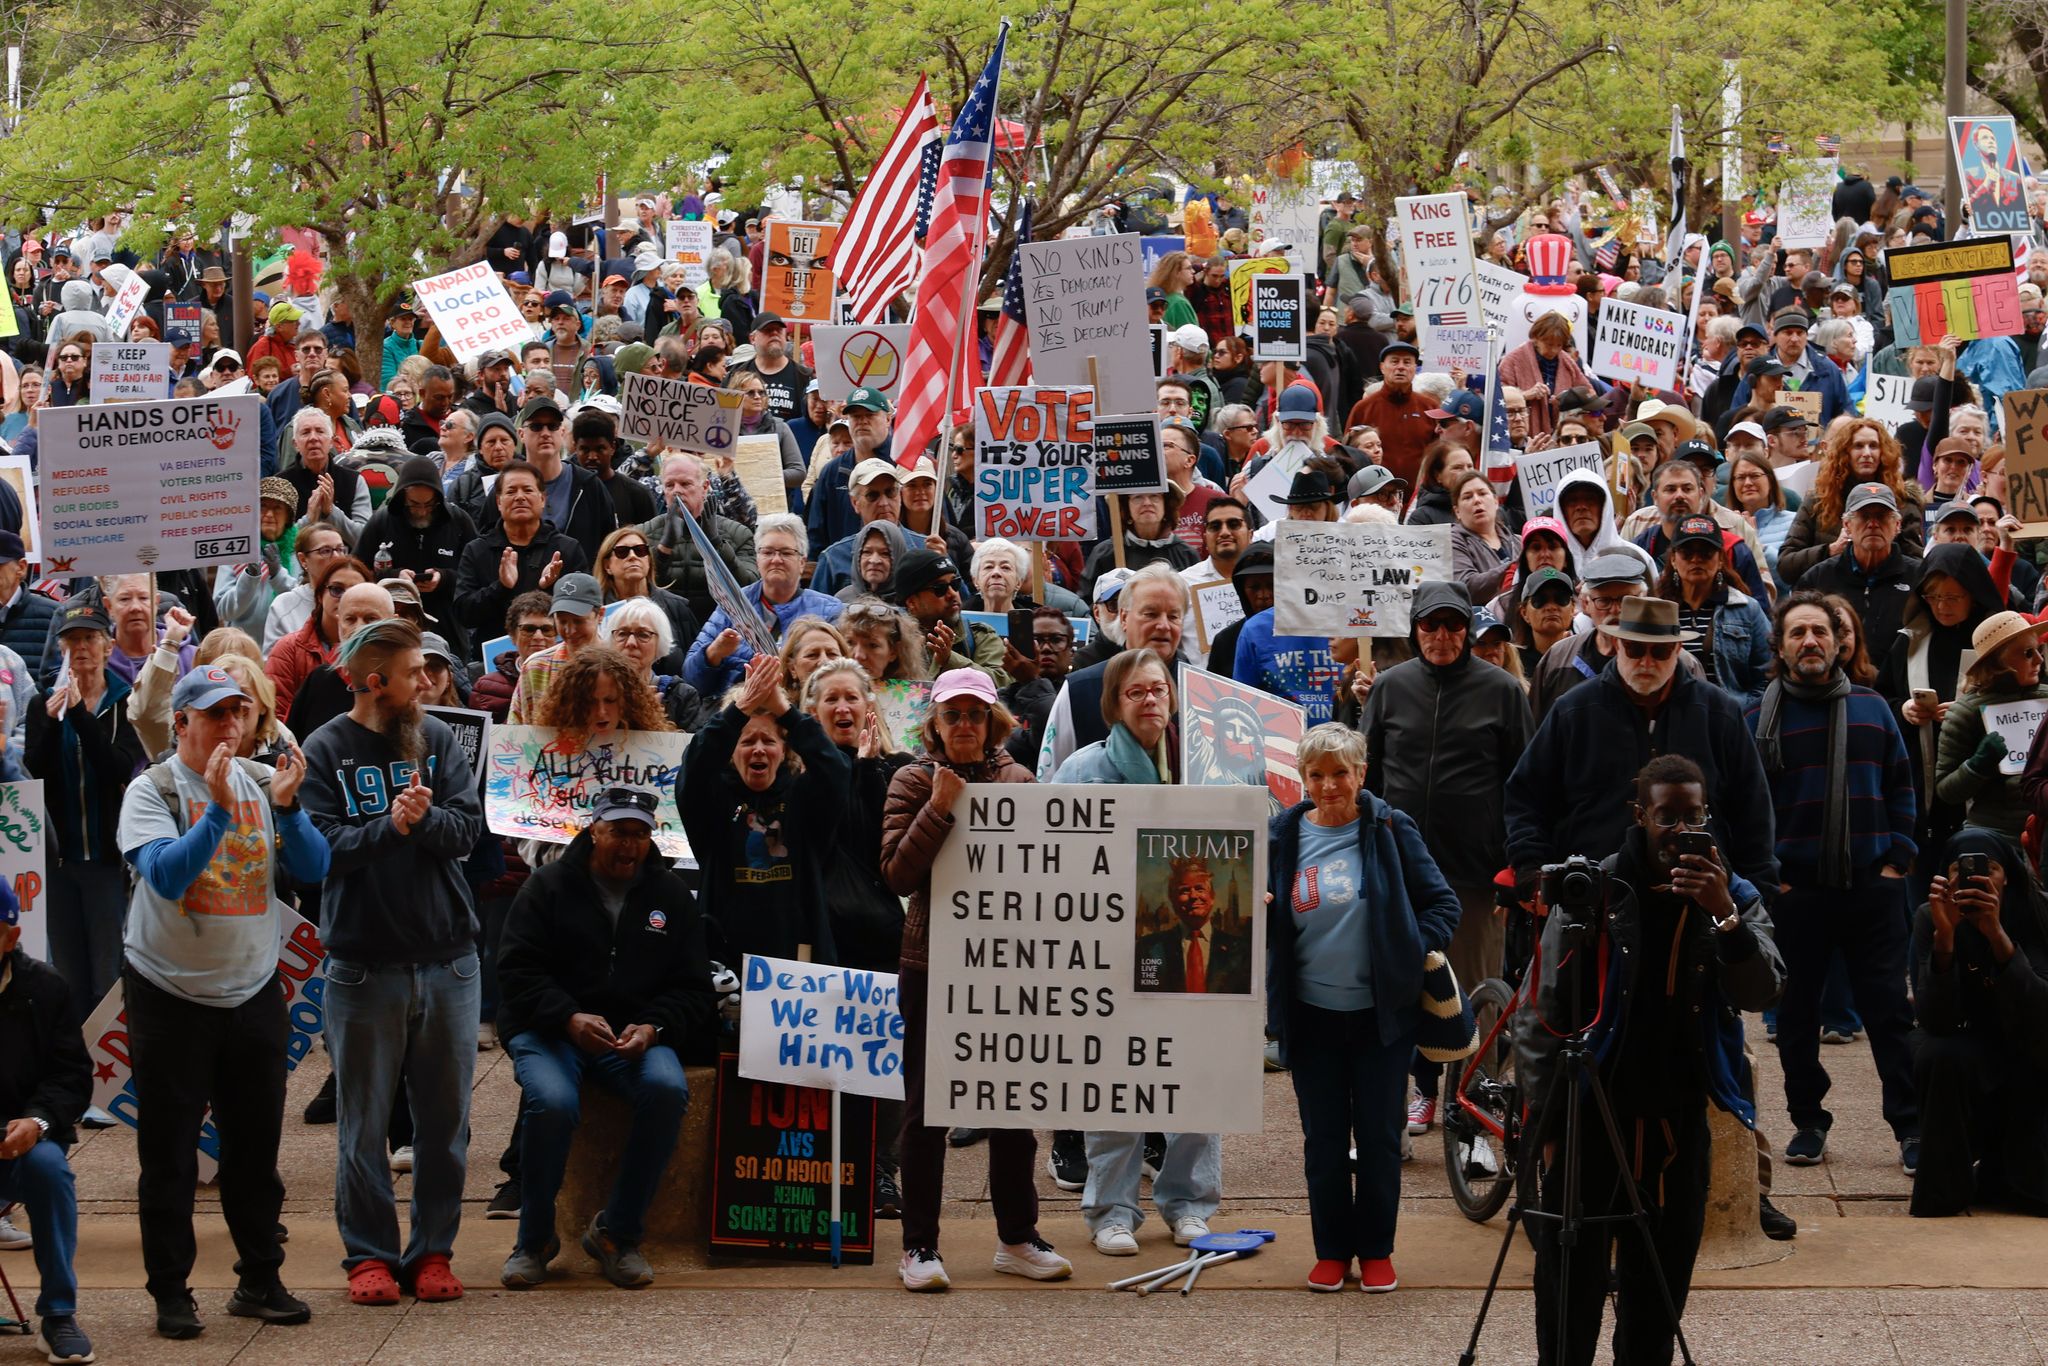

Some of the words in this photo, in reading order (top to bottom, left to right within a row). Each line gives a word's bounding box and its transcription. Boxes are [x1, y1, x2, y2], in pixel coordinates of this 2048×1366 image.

[1253, 210, 1284, 225] ARE
[1409, 202, 1452, 221] KING
[1975, 210, 2029, 229] LOVE
[793, 237, 813, 253] DEI
[1252, 228, 1316, 244] GOVERNING
[1413, 231, 1457, 249] FREE
[1029, 249, 1062, 275] NO
[1075, 241, 1134, 270] KINGS
[415, 264, 488, 296] UNPAID
[1032, 281, 1054, 299] YES
[1061, 274, 1122, 297] DEMOCRACY
[1414, 272, 1472, 308] 1776
[1503, 282, 1516, 291] OF
[433, 286, 500, 312] LOCAL
[1258, 287, 1279, 299] NO
[167, 308, 174, 320] A
[1040, 304, 1062, 324] NO
[1071, 295, 1125, 320] TRUMP
[1258, 299, 1298, 311] KINGS
[1259, 311, 1270, 320] IN
[1271, 311, 1292, 320] OUR
[1892, 280, 2013, 341] VOTE
[456, 306, 501, 330] PRO
[1259, 320, 1292, 329] HOUSE
[1606, 304, 1638, 327] MAKE
[1644, 315, 1674, 336] USA
[452, 319, 526, 353] TESTER
[1039, 329, 1065, 348] YES
[1073, 322, 1129, 343] DECENCY
[1600, 326, 1606, 342] A
[1611, 328, 1676, 359] DEMOCRACY
[118, 348, 147, 360] KEEP
[1450, 344, 1473, 355] NOT
[112, 363, 151, 372] ELECTIONS
[1436, 355, 1482, 369] WARFARE
[1609, 350, 1659, 376] AGAIN
[99, 374, 120, 383] FREE
[123, 373, 142, 383] AND
[144, 374, 164, 383] FAIR
[115, 385, 129, 393] FOR
[131, 385, 146, 393] ALL
[660, 381, 717, 406] KINGS
[77, 408, 165, 433] HANDS
[171, 403, 220, 426] OFF
[626, 394, 658, 417] NO
[658, 398, 698, 423] ICE
[979, 390, 1095, 444] VOTE
[78, 435, 114, 449] OUR
[117, 426, 219, 447] DEMOCRACY
[622, 413, 651, 437] NO
[656, 419, 700, 445] WAR
[160, 462, 174, 472] VA
[175, 457, 226, 471] BENEFITS
[1035, 440, 1095, 467] YOUR
[52, 467, 108, 480] MEDICARE
[160, 476, 202, 488] VOTERS
[204, 472, 244, 485] RIGHTS
[1523, 462, 1552, 488] HEY
[1552, 453, 1601, 479] TRUMP
[52, 484, 111, 497] REFUGEES
[976, 466, 1091, 504] SUPER
[53, 503, 77, 514] OUR
[78, 500, 119, 512] BODIES
[160, 494, 187, 505] CIVIL
[189, 490, 228, 502] RIGHTS
[53, 519, 93, 531] SOCIAL
[95, 514, 149, 527] SECURITY
[160, 509, 198, 522] PUBLIC
[201, 504, 251, 518] SCHOOLS
[984, 503, 1088, 538] POWER
[53, 533, 125, 548] HEALTHCARE
[161, 527, 188, 538] FREE
[191, 523, 233, 536] SPEECH
[1325, 534, 1357, 547] BRING
[198, 542, 220, 556] 86
[225, 539, 247, 553] 47
[1412, 549, 1441, 562] SOCIAL
[1295, 555, 1342, 568] SECURITY
[1309, 568, 1346, 582] RULE
[1351, 573, 1366, 582] OF
[1372, 565, 1425, 586] LAW?
[1304, 588, 1346, 605] DUMP
[1273, 650, 1306, 668] WE
[1299, 694, 1329, 702] SERVE
[465, 725, 480, 736] ARE
[529, 749, 584, 782] ALL
[593, 754, 669, 787] future
[336, 755, 438, 818] 195
[970, 797, 1015, 826] NO
[1046, 798, 1116, 828] ONE
[1141, 833, 1249, 860] TRUMP
[966, 843, 1061, 874] WITH
[1092, 845, 1111, 875] A
[951, 890, 1125, 923] SERIOUS
[965, 937, 1111, 970] MENTAL
[1141, 957, 1163, 966] LONG
[745, 956, 838, 993] Dear
[1141, 965, 1158, 973] LIVE
[1141, 972, 1157, 980] THE
[1141, 978, 1160, 987] KING
[948, 984, 1115, 1018] ILLNESS
[771, 998, 824, 1029] We
[835, 1006, 905, 1040] Hate
[780, 1032, 854, 1072] Him
[862, 1038, 905, 1077] To
[954, 1032, 1101, 1065] SHOULD
[1128, 1036, 1173, 1067] BE
[950, 1080, 1181, 1114] PRESIDENT
[776, 1130, 815, 1158] SAY
[735, 1155, 758, 1180] US
[762, 1157, 782, 1181] OF
[786, 1159, 855, 1186] EOUGH
[774, 1185, 815, 1206] WHEN
[728, 1204, 777, 1233] ENDS
[782, 1208, 812, 1234] ALL
[817, 1210, 858, 1238] THS
